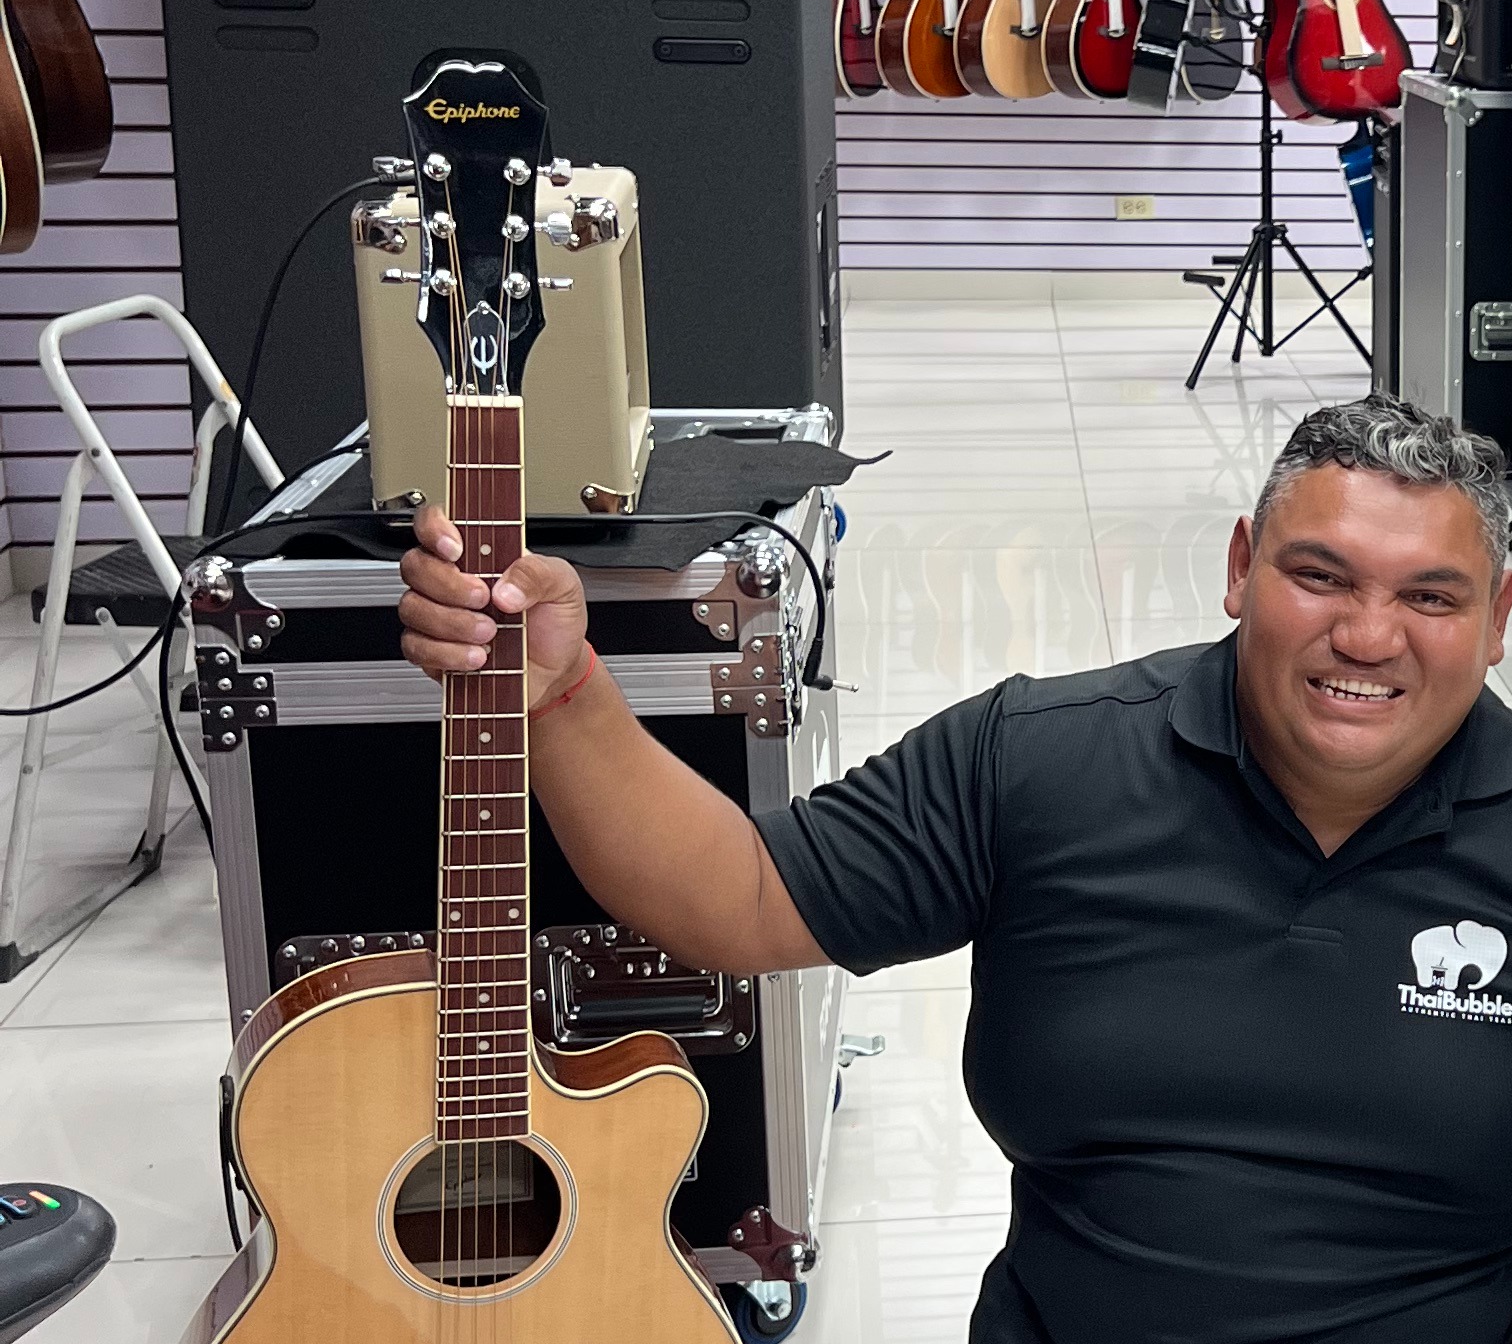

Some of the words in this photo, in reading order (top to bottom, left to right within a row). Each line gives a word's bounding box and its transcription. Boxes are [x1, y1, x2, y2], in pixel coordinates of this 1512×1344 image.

[424, 98, 521, 124] Epiphone
[1400, 1005, 1456, 1019] AUTHENTIC
[1461, 1012, 1484, 1022] THAI
[1488, 1016, 1512, 1025] TEAS
